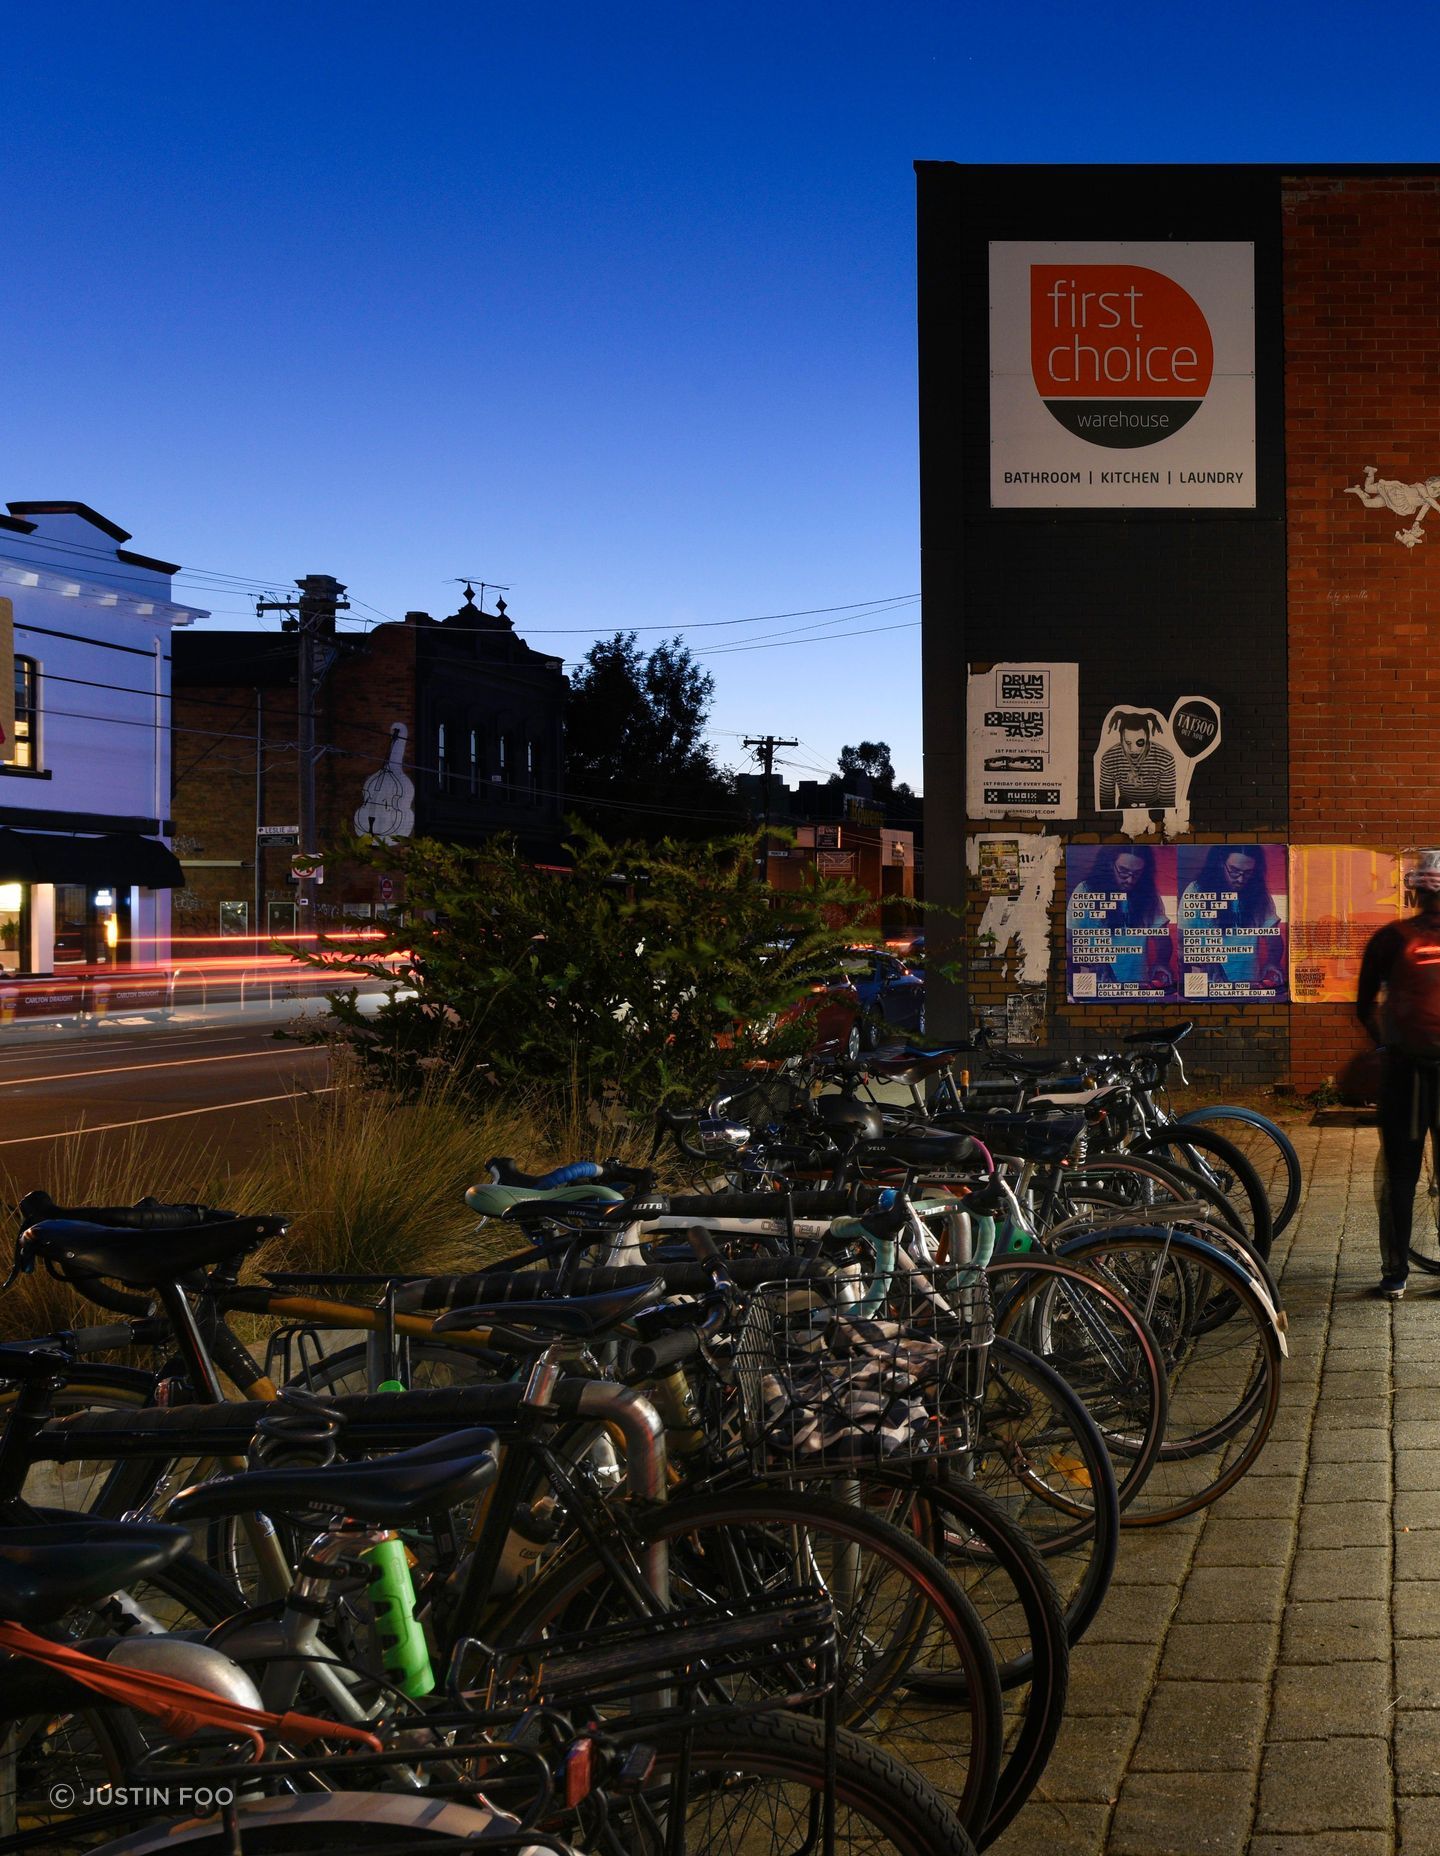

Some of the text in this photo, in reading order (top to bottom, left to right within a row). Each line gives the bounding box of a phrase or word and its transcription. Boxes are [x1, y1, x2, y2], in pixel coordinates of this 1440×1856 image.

[1047, 279, 1144, 330] first
[1048, 333, 1199, 383] choice
[1076, 410, 1170, 429] warehouse
[1003, 470, 1244, 485] BATHROOM KITCHEN LAUNDRY
[1002, 674, 1043, 685] DRUM
[1002, 690, 1043, 700] BASS
[1177, 713, 1215, 736] TABOO
[25, 995, 73, 1004] CARLTON DRAUGHT
[116, 990, 160, 999] CARLTON DRAUGHT
